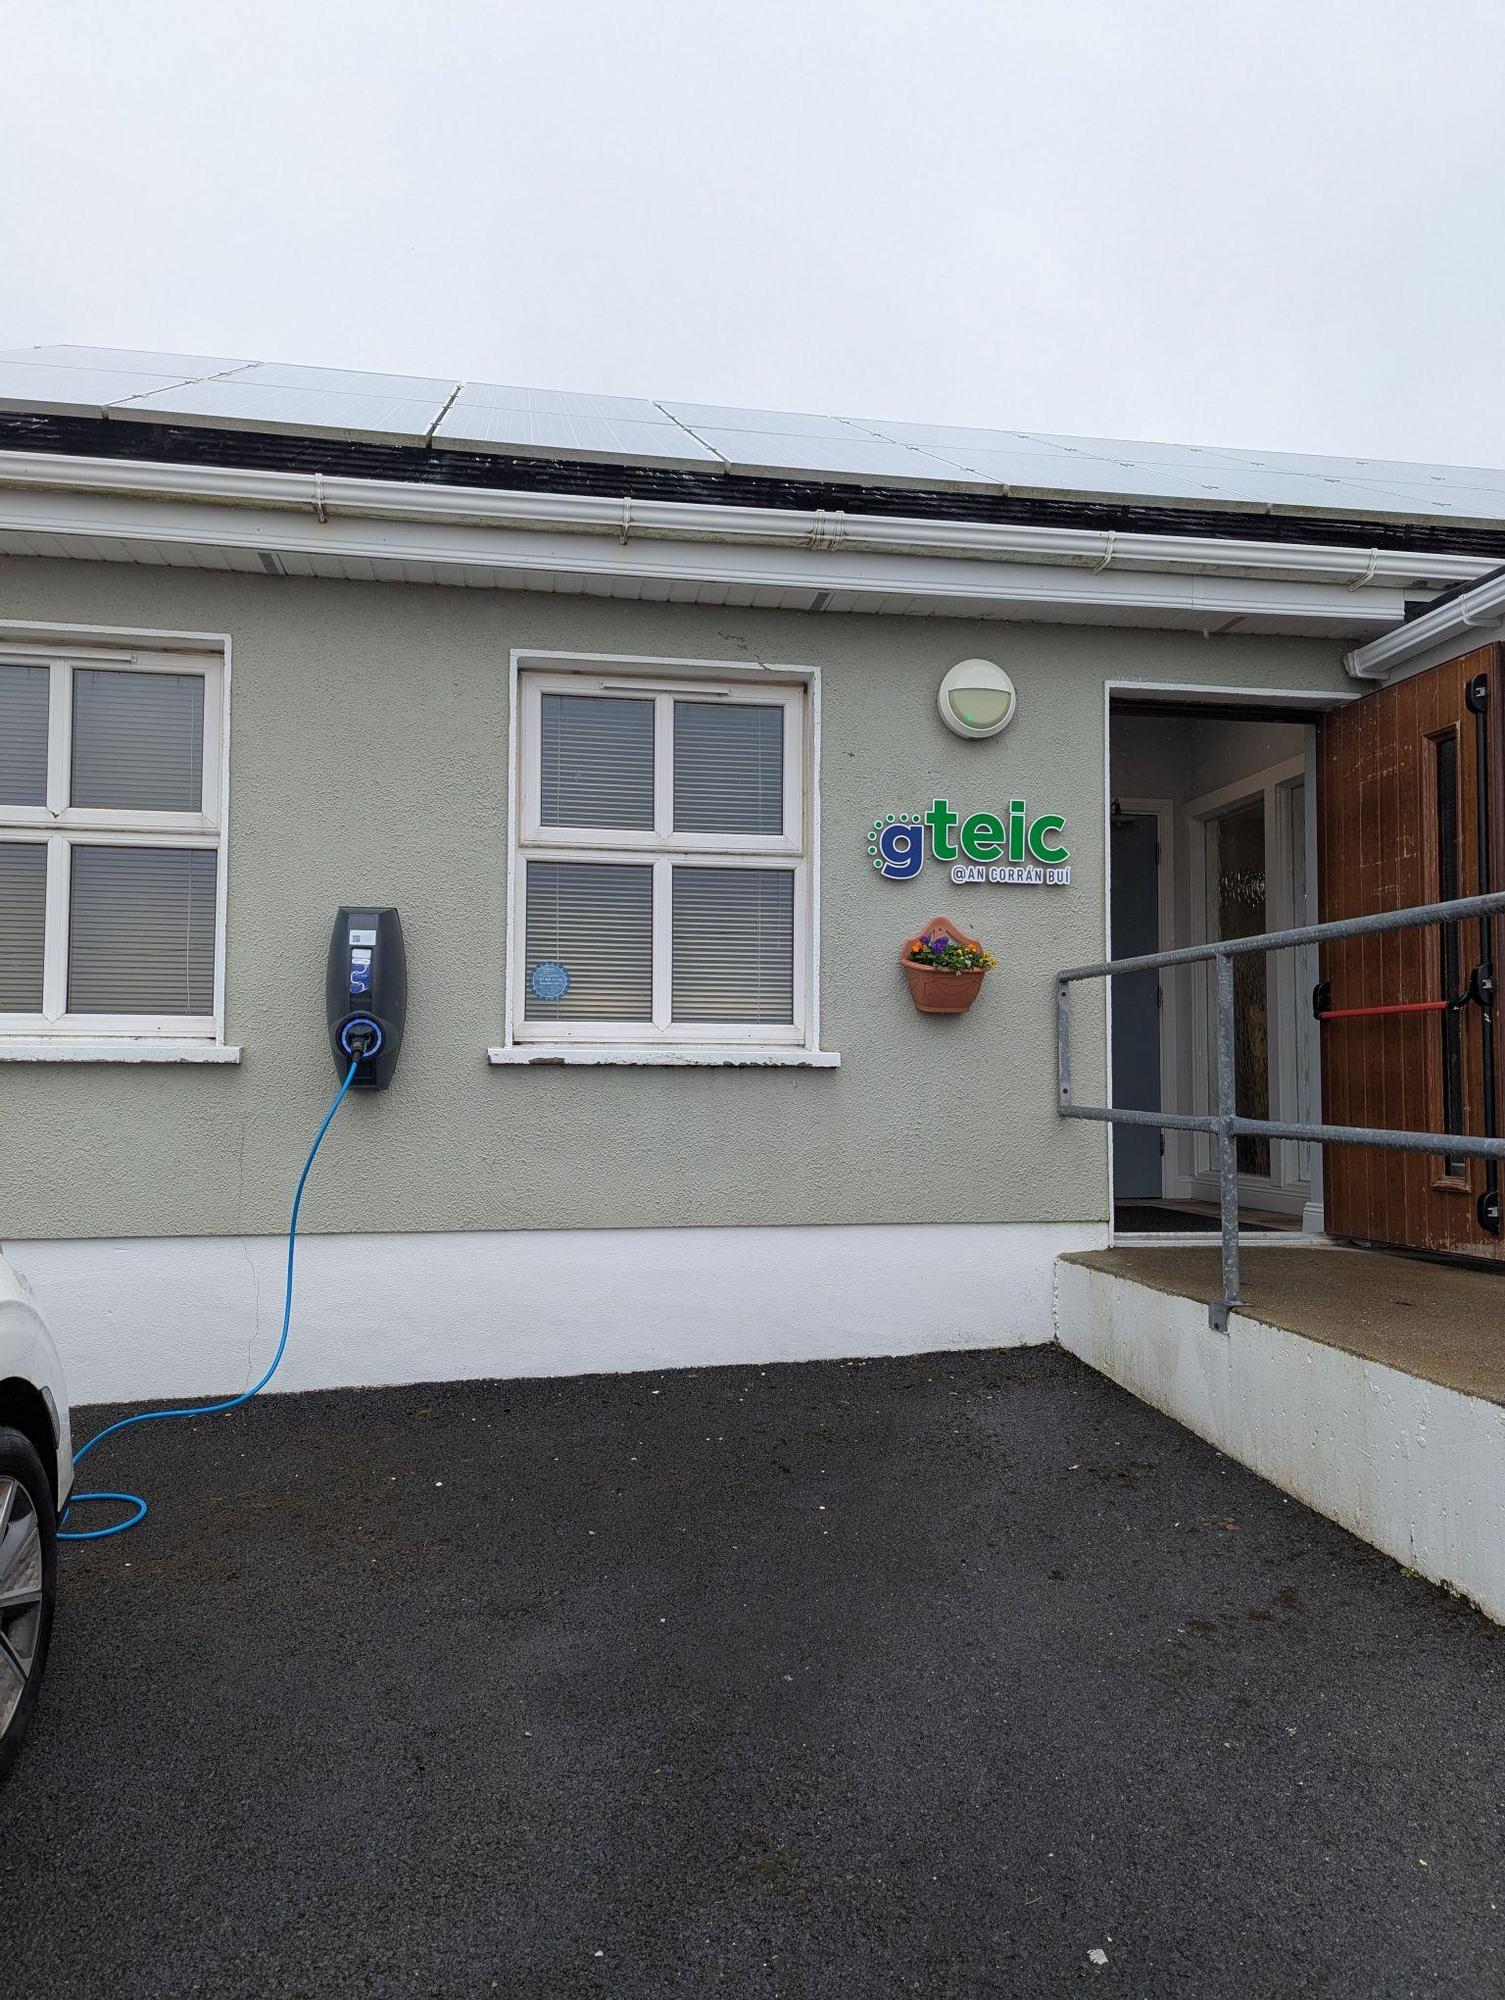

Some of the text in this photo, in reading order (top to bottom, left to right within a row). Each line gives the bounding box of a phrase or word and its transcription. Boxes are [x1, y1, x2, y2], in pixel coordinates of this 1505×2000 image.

[880, 799, 1070, 879] gteic
[952, 865, 1071, 884] @AN CORRÁN BUÍ
